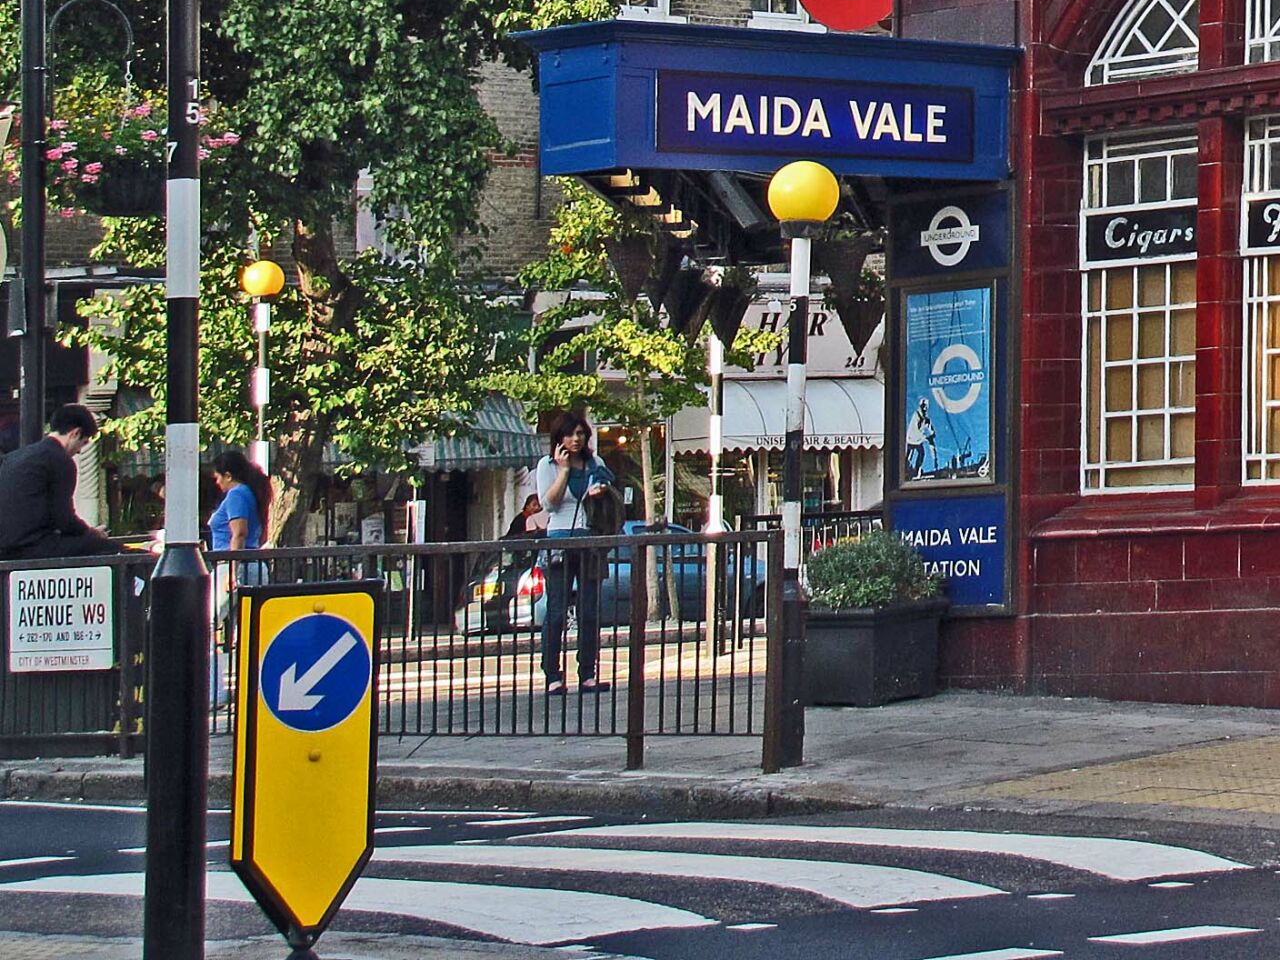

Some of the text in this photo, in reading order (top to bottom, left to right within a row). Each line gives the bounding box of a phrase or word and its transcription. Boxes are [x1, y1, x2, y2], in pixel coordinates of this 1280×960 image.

[687, 91, 947, 143] MAIDA VALE
[1104, 216, 1195, 254] Cigars
[928, 371, 985, 386] UNDERGROUND
[834, 435, 872, 445] BEAUTY
[900, 526, 997, 547] MAIDA VALE
[922, 559, 981, 577] TATION
[18, 576, 93, 601] RANDOLPH
[18, 603, 105, 628] AVENUE W9
[55, 631, 70, 642] AND
[44, 655, 90, 666] WESTMINSTER
